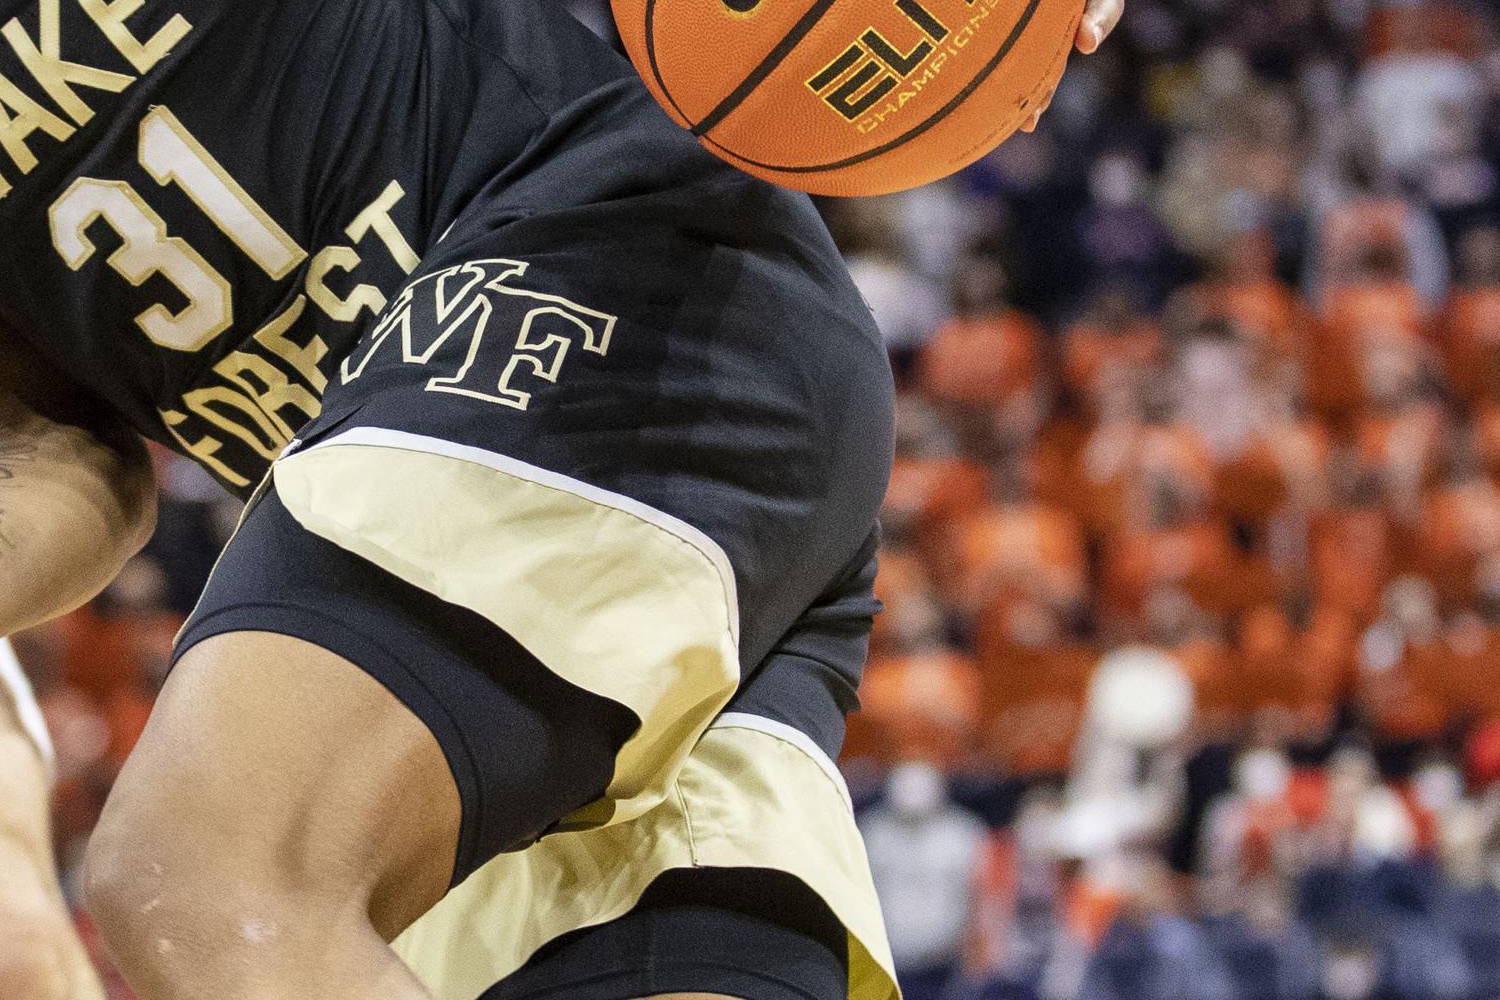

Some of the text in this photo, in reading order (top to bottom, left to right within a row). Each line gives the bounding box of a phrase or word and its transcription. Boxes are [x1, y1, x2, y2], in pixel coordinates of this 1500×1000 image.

[48, 104, 309, 352] 31
[156, 178, 422, 488] FOREST
[340, 257, 619, 412] WF
